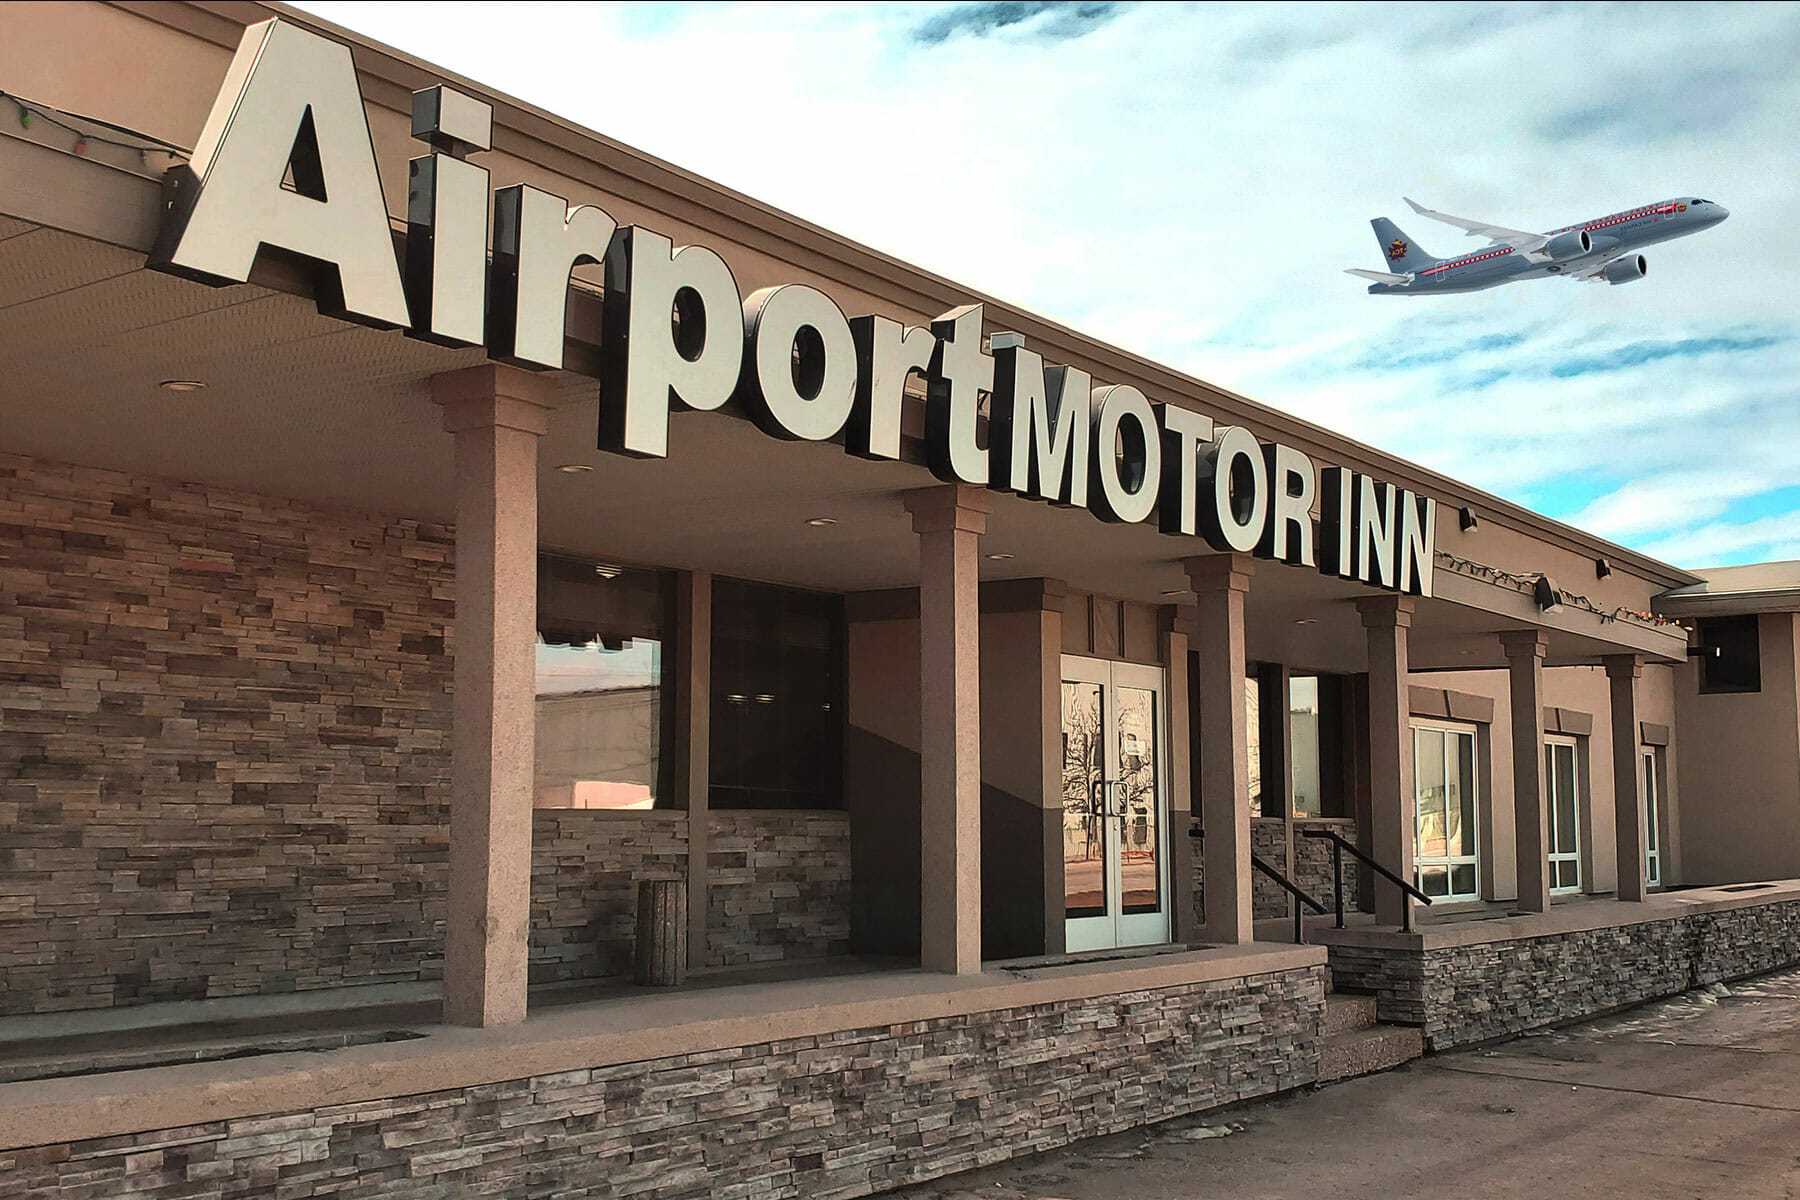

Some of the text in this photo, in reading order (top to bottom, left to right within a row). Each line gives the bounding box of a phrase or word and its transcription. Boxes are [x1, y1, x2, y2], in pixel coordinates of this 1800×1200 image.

[170, 17, 1436, 598] Airport MOTOR INN
